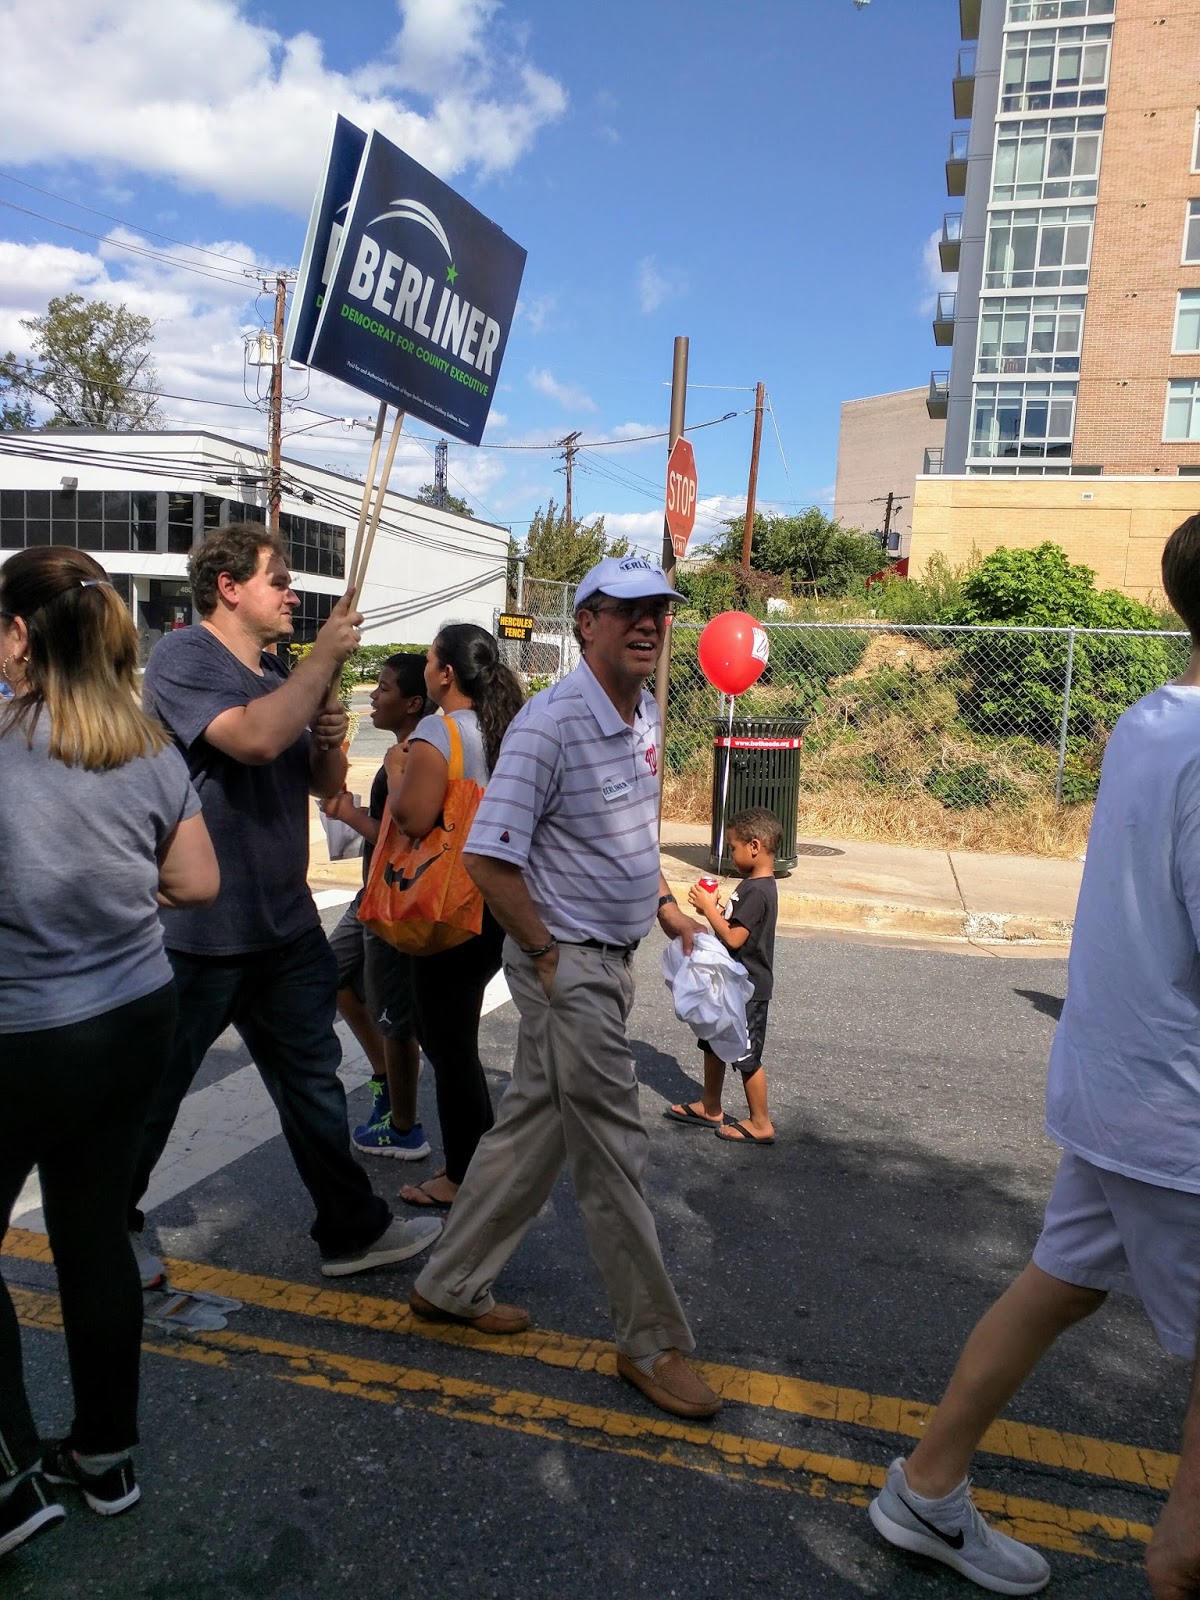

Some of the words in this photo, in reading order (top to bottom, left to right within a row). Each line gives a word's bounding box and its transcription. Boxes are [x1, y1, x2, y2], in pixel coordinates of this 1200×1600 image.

[348, 234, 500, 376] BERLINER
[340, 304, 396, 343] DEMOCRAT
[397, 335, 415, 355] FOR
[416, 347, 450, 373] COUNTY
[449, 365, 489, 397] EXECUTIVE
[668, 470, 695, 517] STOP
[500, 616, 533, 629] HERCULES
[504, 627, 526, 639] FENCE
[734, 740, 790, 748] www.bethesda.org
